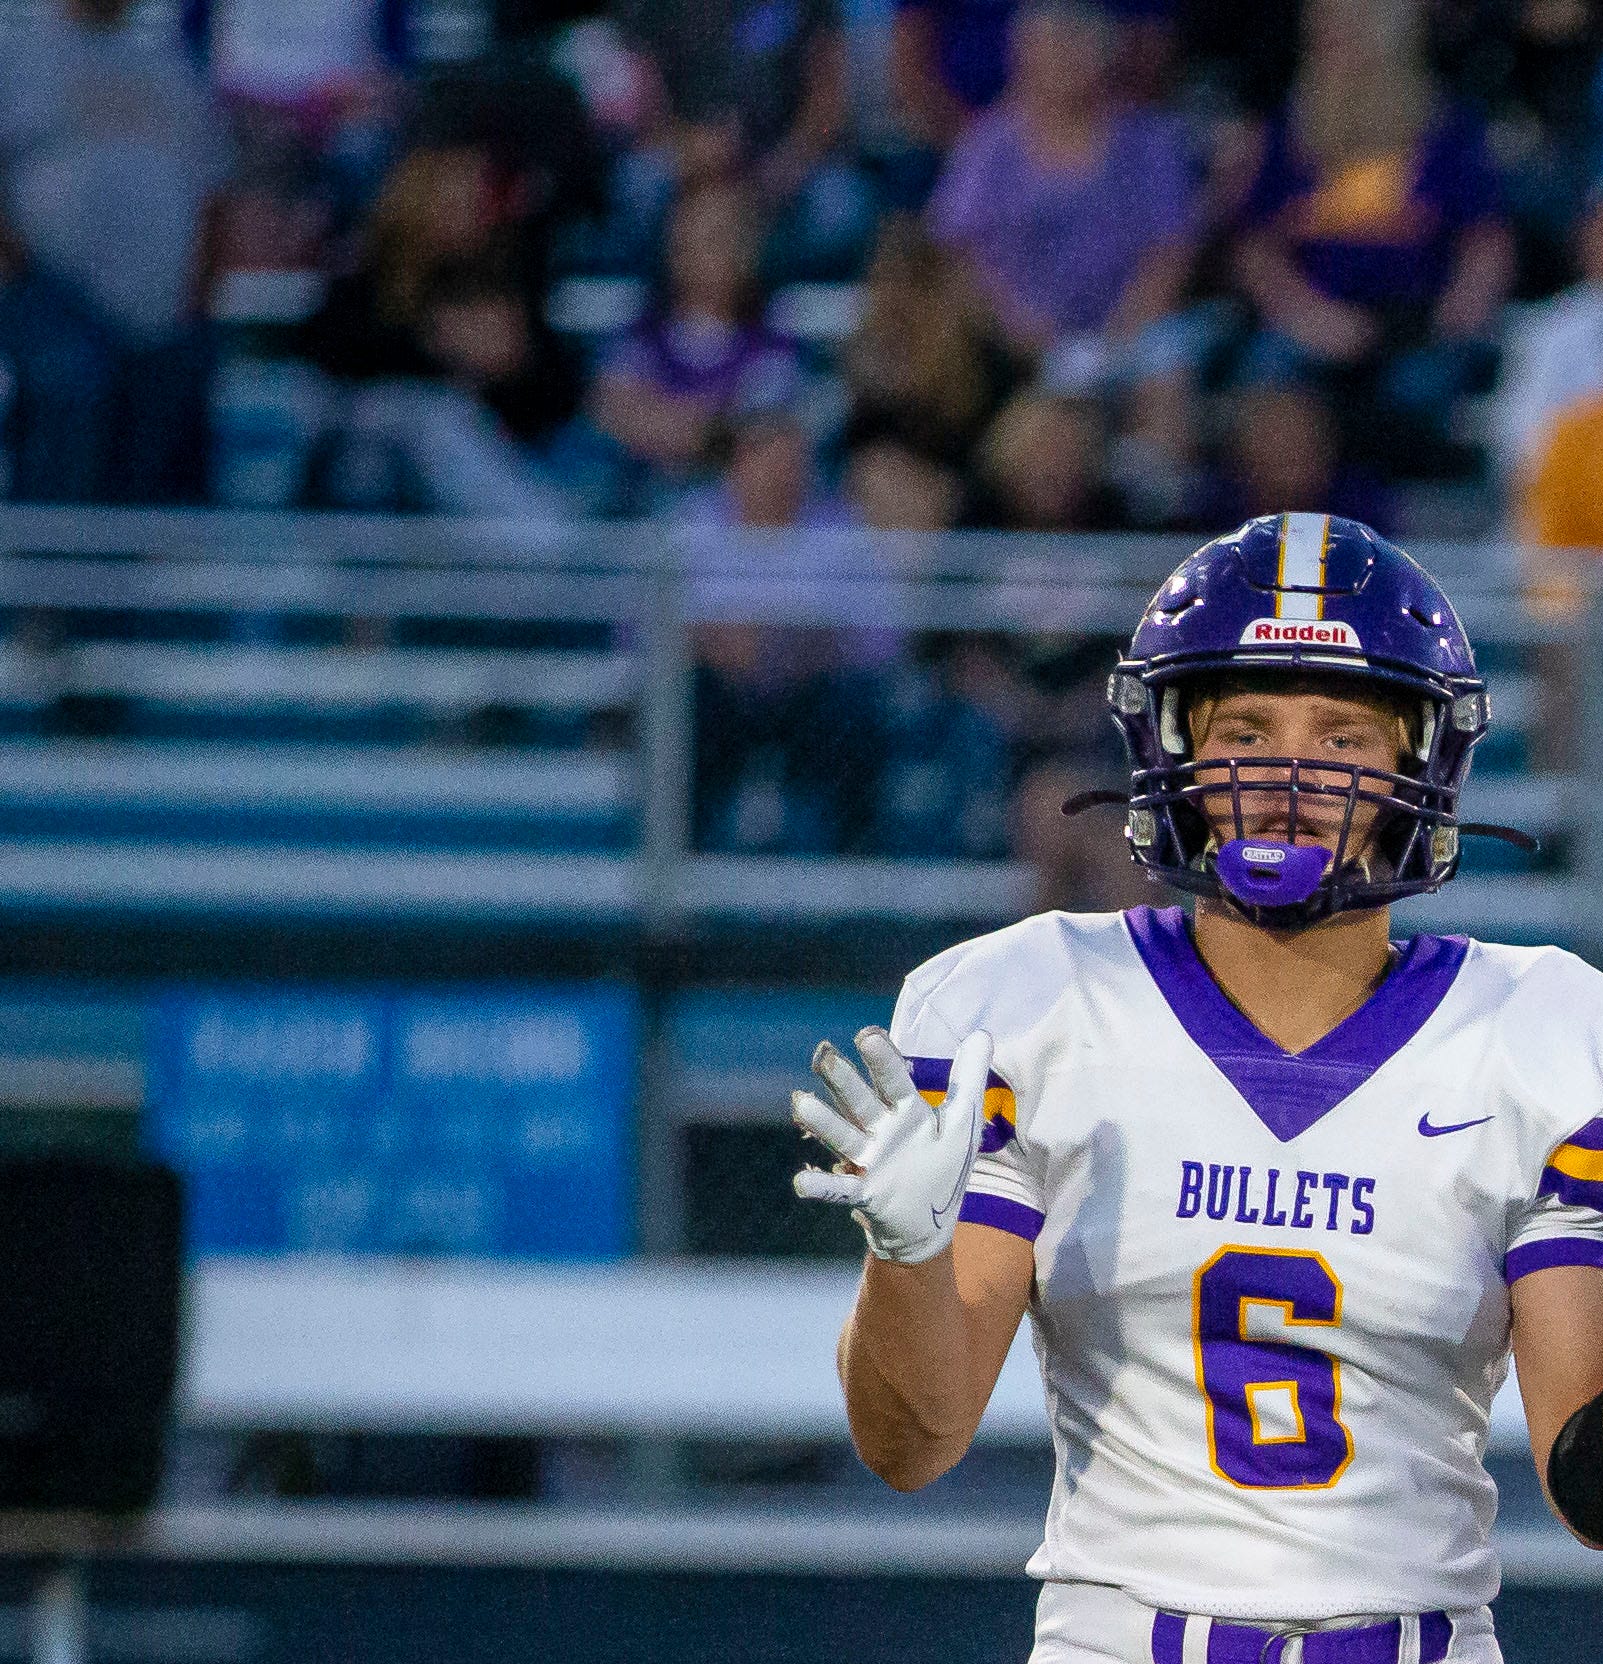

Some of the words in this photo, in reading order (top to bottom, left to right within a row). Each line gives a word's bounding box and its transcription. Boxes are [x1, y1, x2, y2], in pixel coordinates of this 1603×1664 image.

[1256, 623, 1346, 643] Riddell
[1176, 1161, 1376, 1235] BULLETS
[1191, 1243, 1355, 1491] 6
